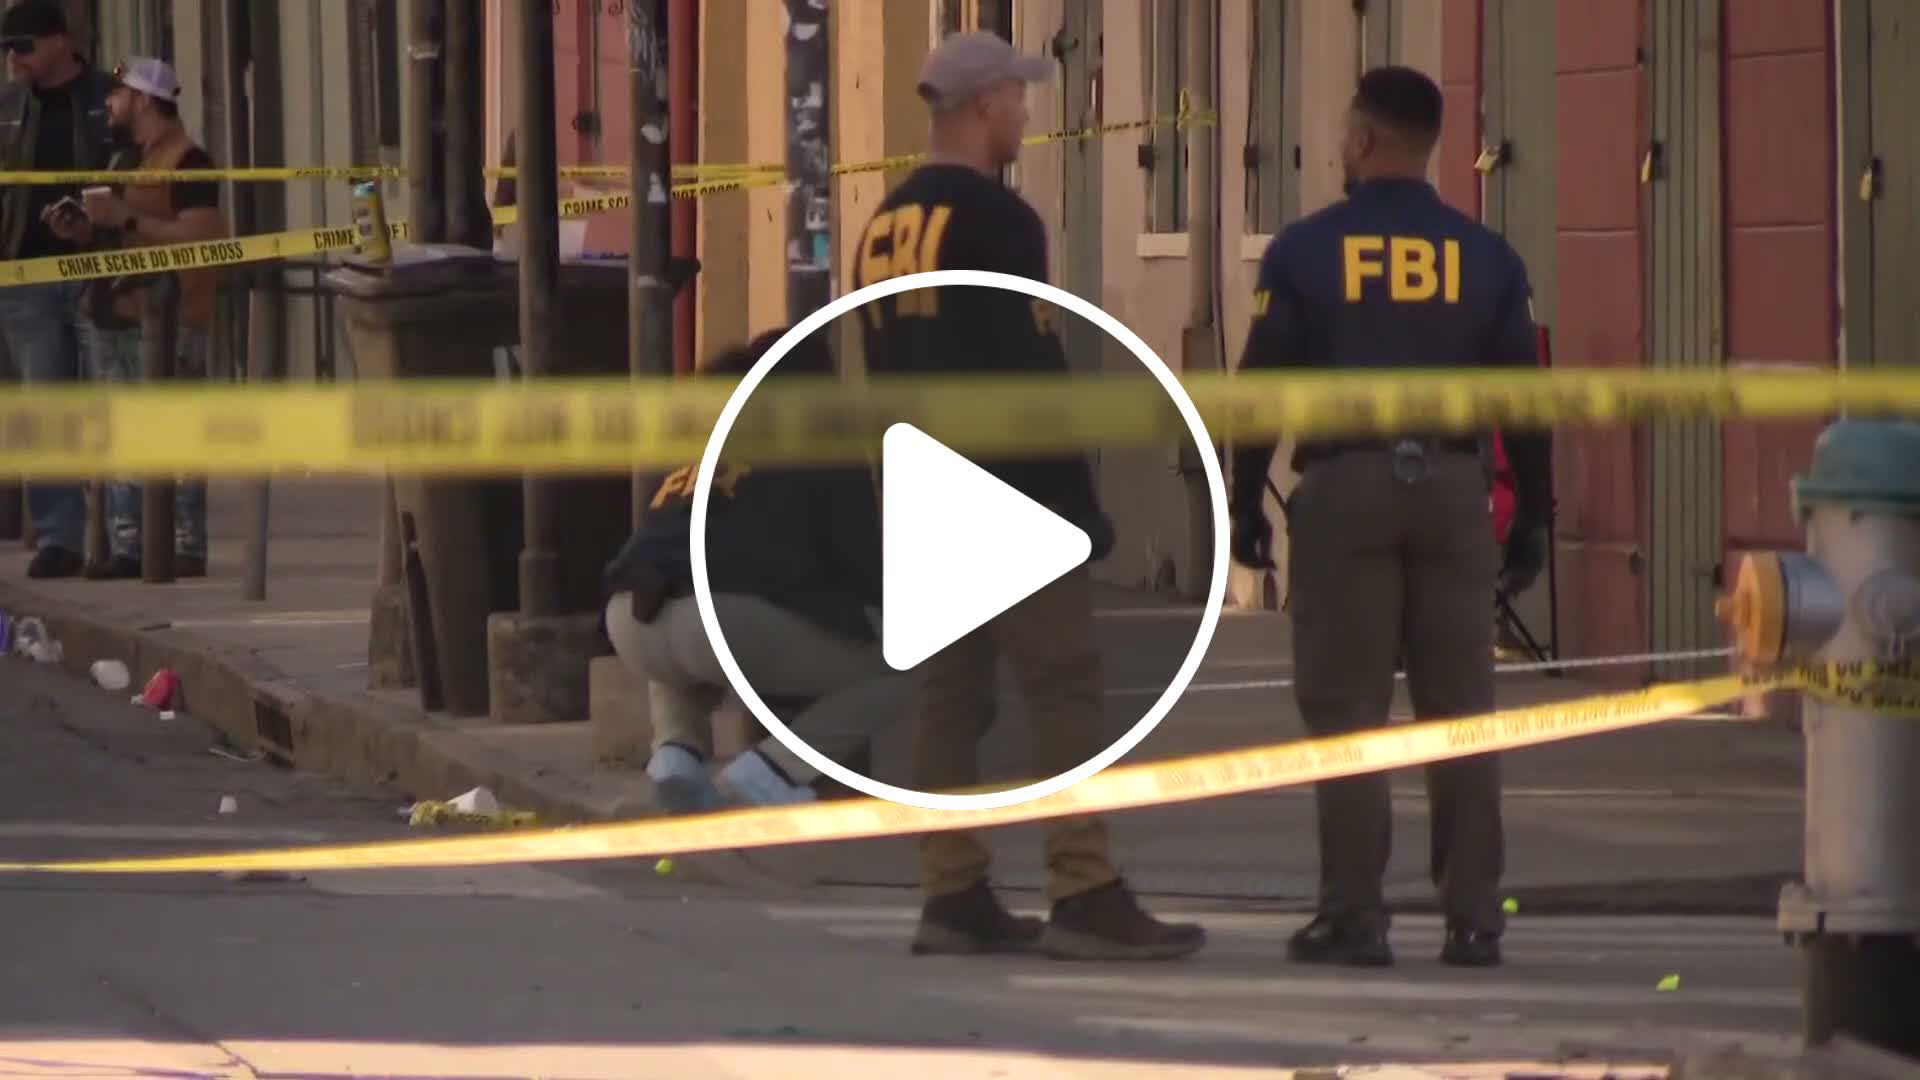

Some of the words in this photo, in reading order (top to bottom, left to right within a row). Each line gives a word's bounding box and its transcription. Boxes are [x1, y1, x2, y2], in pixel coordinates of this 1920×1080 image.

[563, 199, 603, 216] CRIME
[313, 229, 354, 249] CRIME
[58, 258, 101, 278] CRIME
[104, 251, 148, 275] SCENE
[149, 249, 169, 269] DO
[171, 246, 197, 267] NOT
[199, 241, 244, 264] CROSS
[859, 203, 952, 328] FBI
[1343, 236, 1460, 304] FBI
